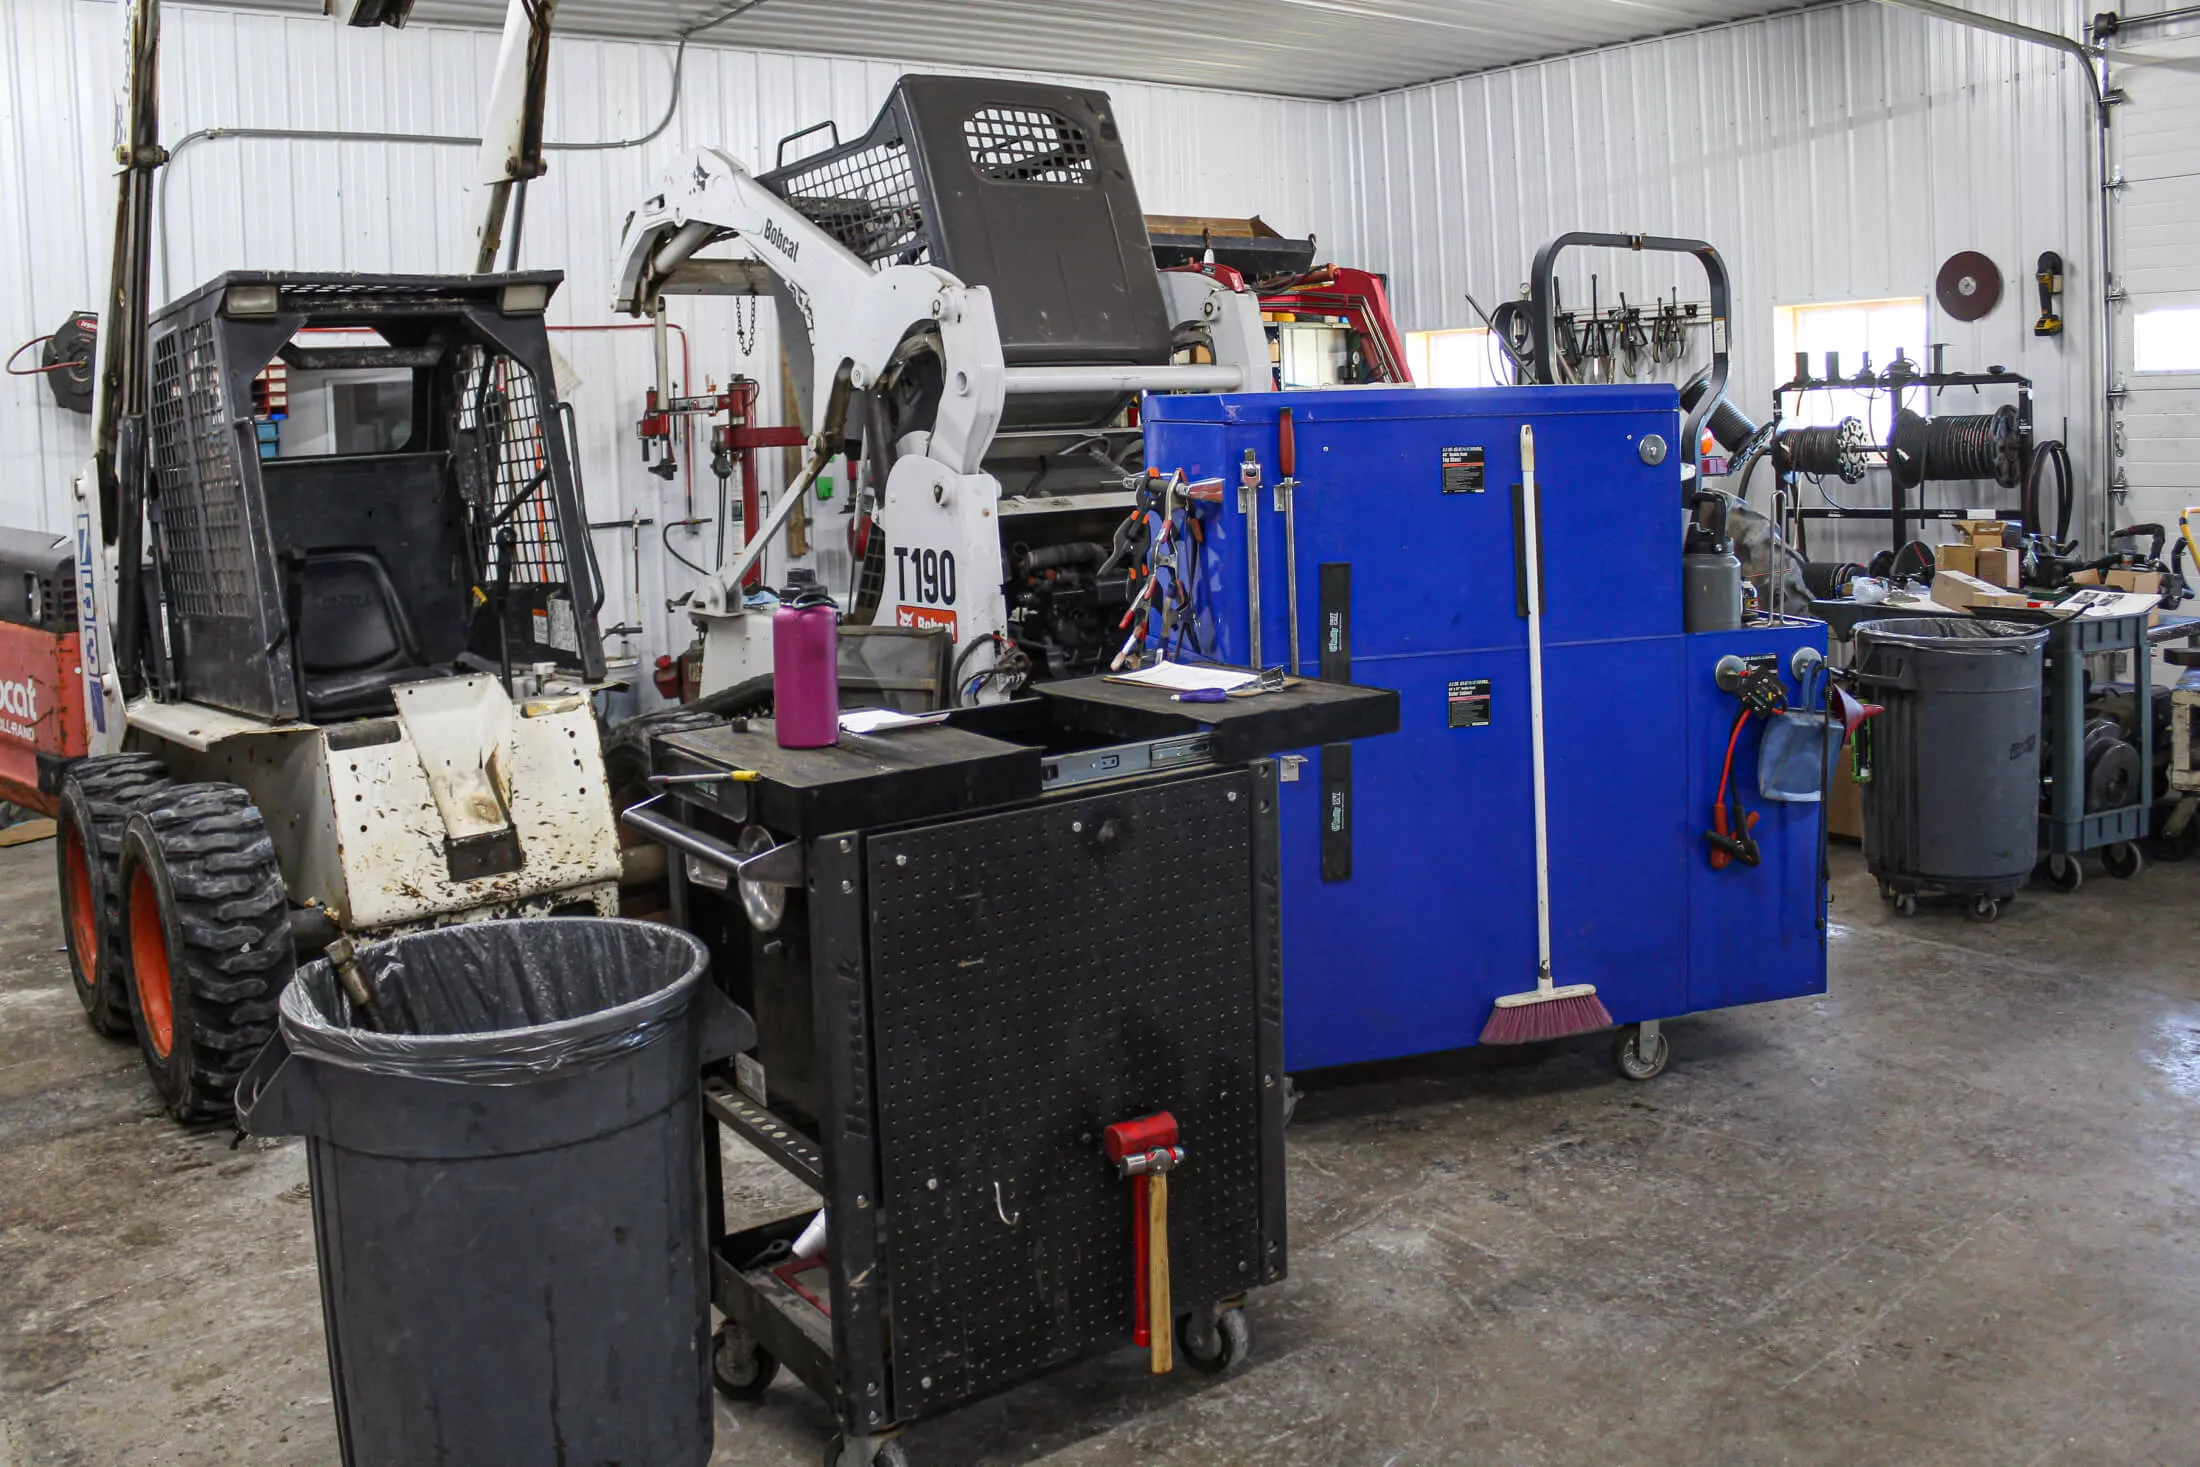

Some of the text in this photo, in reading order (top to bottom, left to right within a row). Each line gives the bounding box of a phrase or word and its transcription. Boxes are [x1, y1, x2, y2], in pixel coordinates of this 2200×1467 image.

[764, 217, 799, 263] Bobcat
[77, 513, 101, 678] 753
[893, 546, 957, 606] T190
